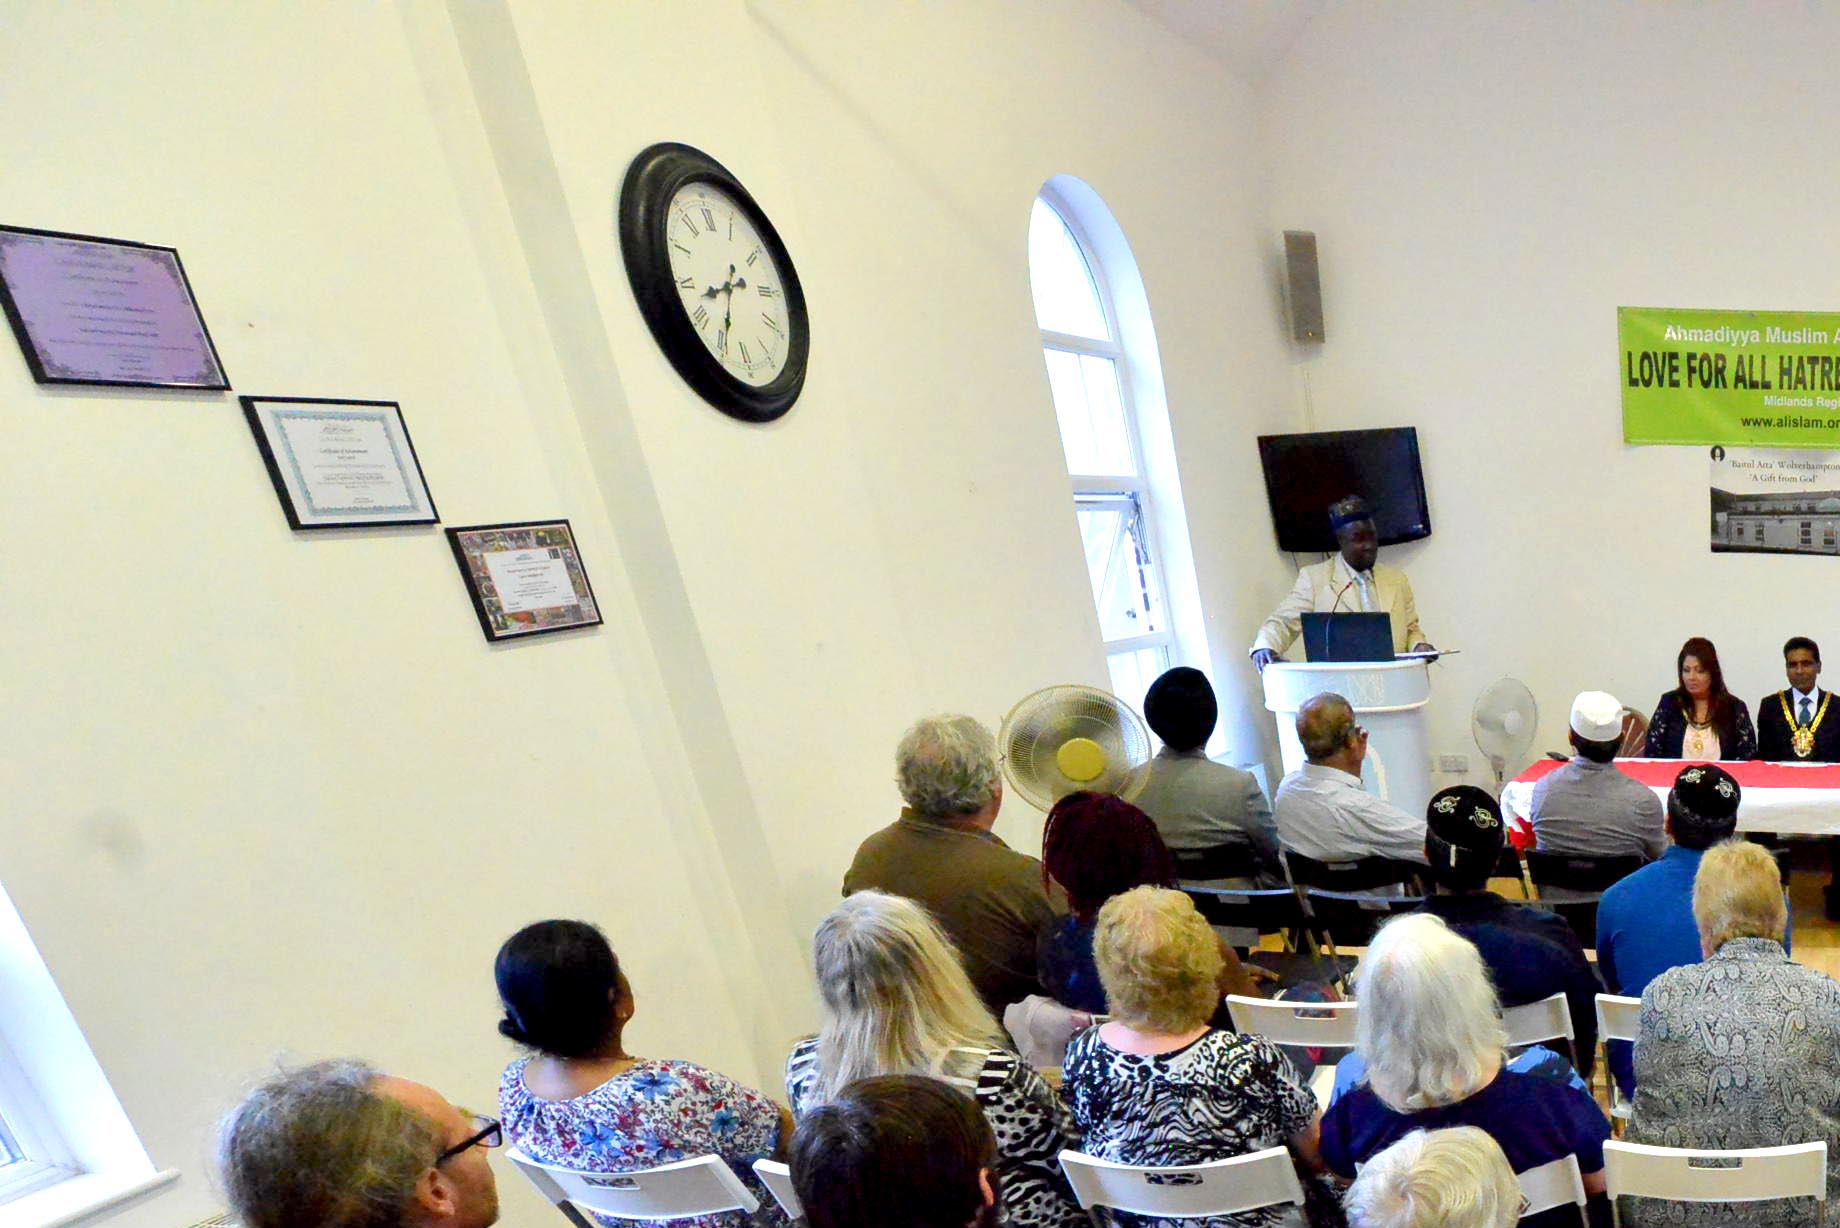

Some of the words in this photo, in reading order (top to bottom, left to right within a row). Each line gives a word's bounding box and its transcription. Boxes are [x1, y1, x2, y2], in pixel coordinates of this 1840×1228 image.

[1664, 325, 1760, 347] Ahmadiyya
[1766, 327, 1828, 345] Muslim
[1627, 350, 1681, 389] LOVE
[1687, 351, 1728, 390] FOR
[1734, 354, 1772, 390] ALL
[1764, 395, 1813, 407] Midlands
[1777, 459, 1840, 472] Wolverhampton
[1760, 474, 1776, 482] Gift
[1778, 474, 1798, 483] from
